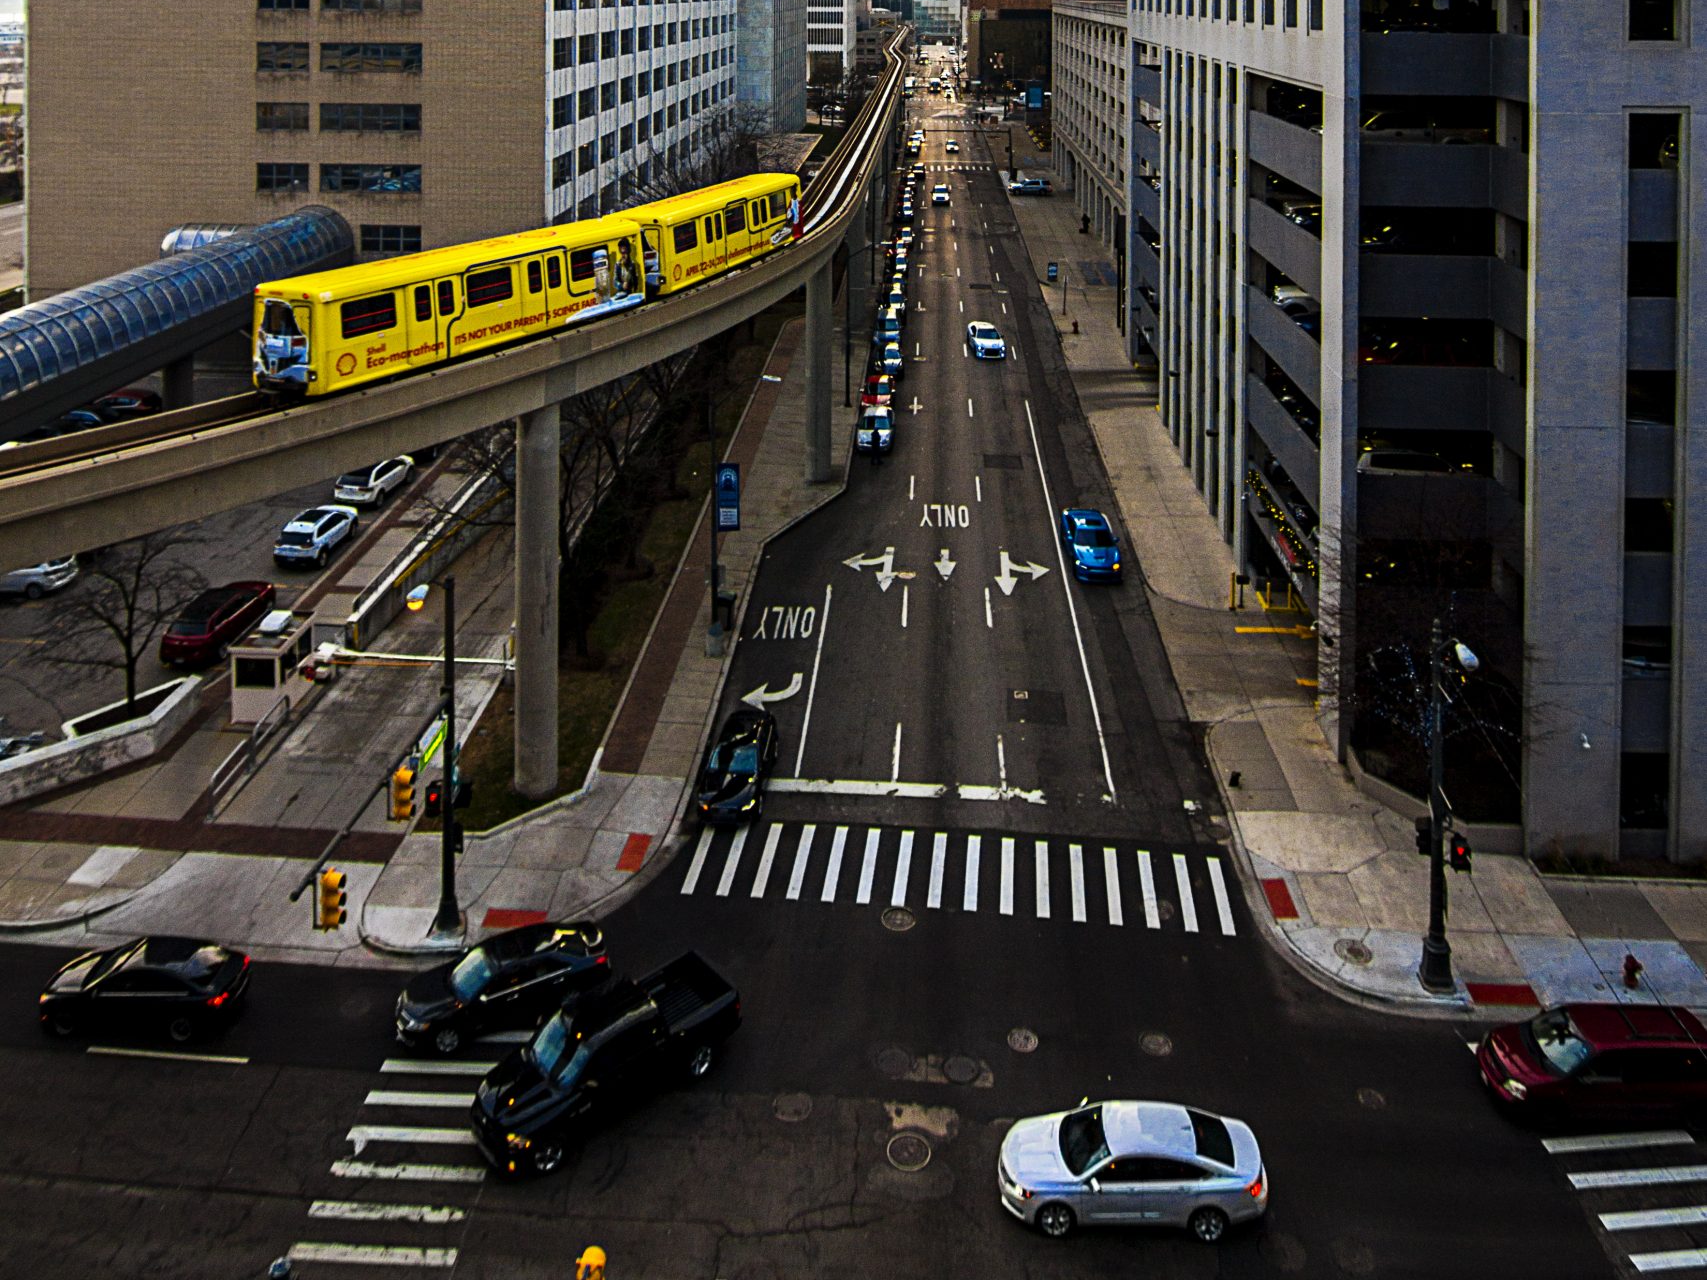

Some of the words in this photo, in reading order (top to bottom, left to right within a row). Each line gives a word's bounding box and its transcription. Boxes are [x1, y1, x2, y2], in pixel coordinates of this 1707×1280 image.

[468, 329, 488, 341] NOT
[488, 321, 512, 335] YOUR
[553, 302, 580, 319] SCIENCE
[366, 343, 387, 356] Shell
[366, 341, 445, 369] Eco-marathon
[919, 503, 970, 528] ONLY
[752, 606, 816, 640] ONLY
